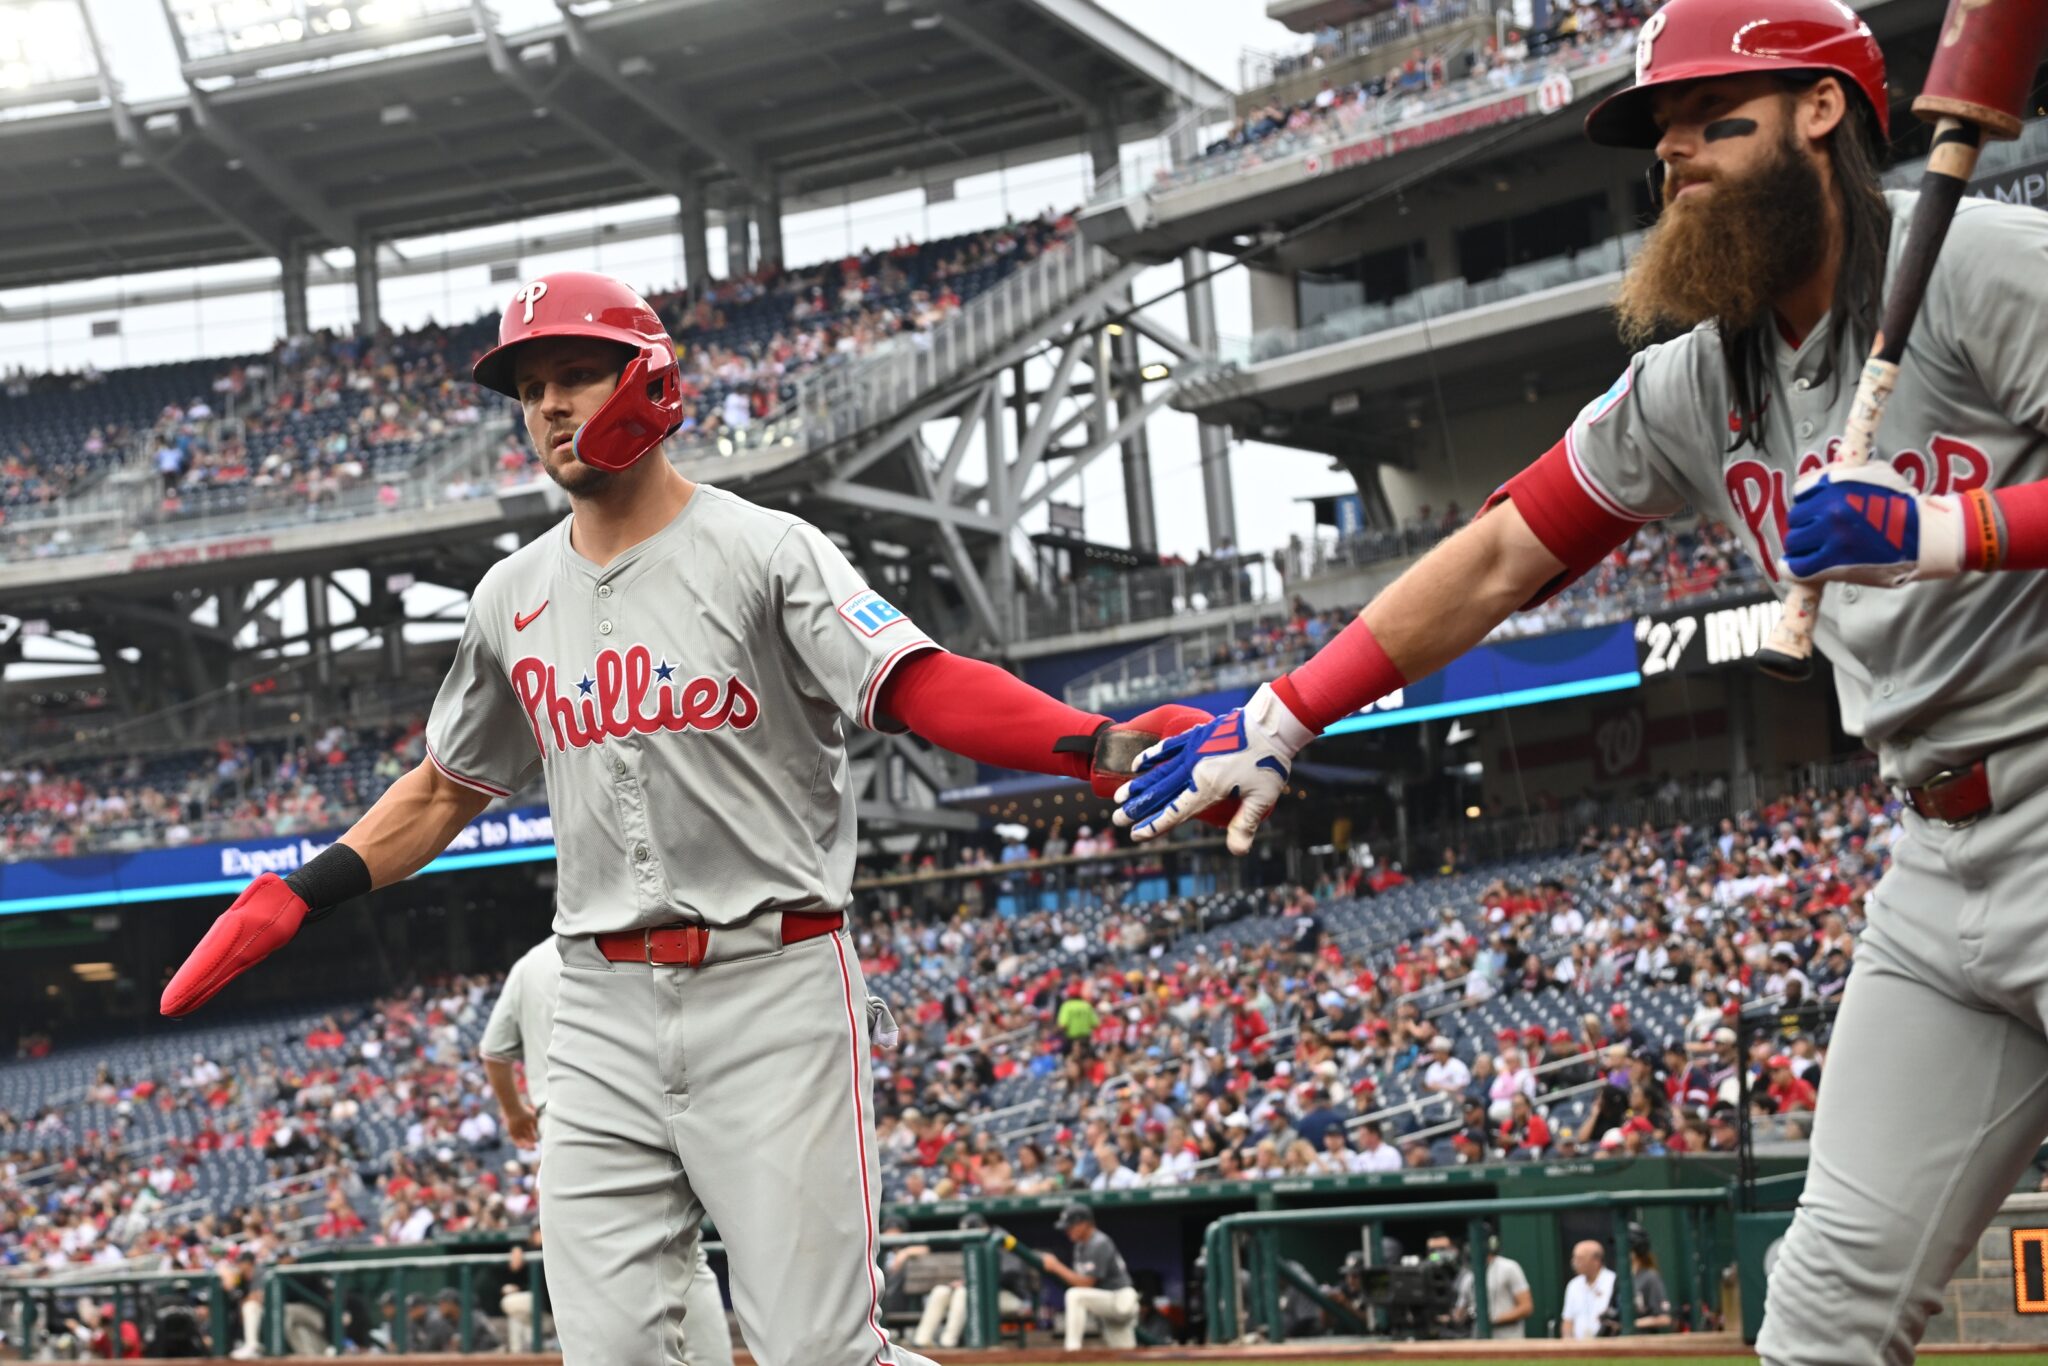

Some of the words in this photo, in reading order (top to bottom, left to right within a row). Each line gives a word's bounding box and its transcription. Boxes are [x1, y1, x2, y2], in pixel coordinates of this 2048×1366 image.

[1636, 11, 1667, 71] P
[517, 281, 548, 325] P
[511, 643, 760, 760] Phillies
